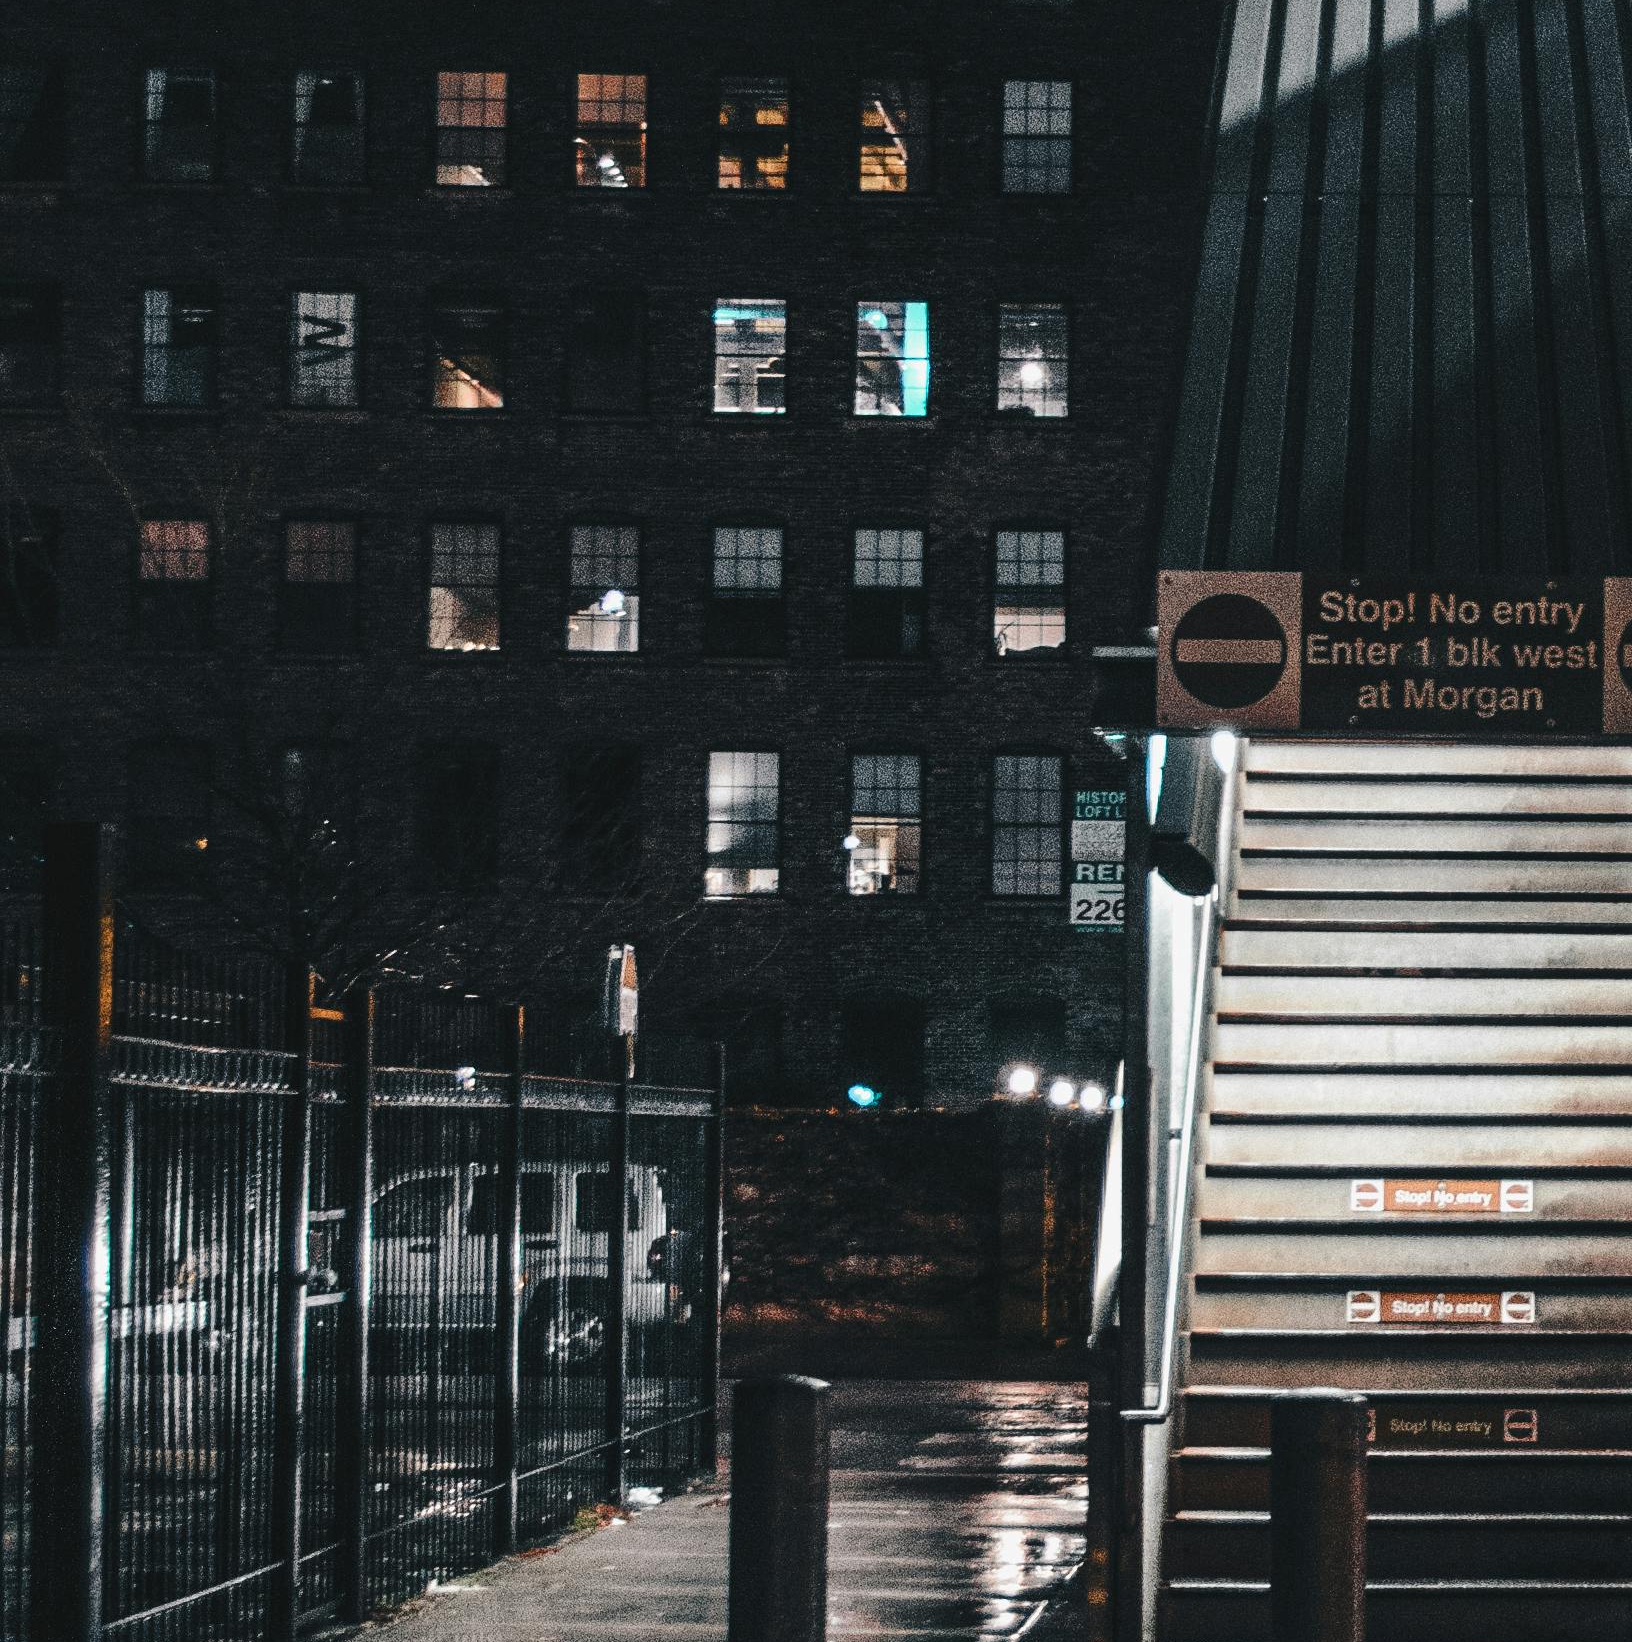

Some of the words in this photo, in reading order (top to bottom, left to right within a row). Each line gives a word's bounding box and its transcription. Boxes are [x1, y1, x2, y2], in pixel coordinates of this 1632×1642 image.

[1319, 590, 1416, 631] Stop!
[1430, 592, 1481, 625] No
[1492, 596, 1585, 633] entry
[1306, 633, 1402, 666] Enter
[1416, 636, 1431, 667] 1
[1448, 636, 1501, 667] blk
[1513, 639, 1598, 668] west
[1358, 679, 1391, 709] at
[1403, 678, 1544, 718] Morgan
[1076, 805, 1111, 818] LOFT
[1395, 1189, 1431, 1205] Stop!
[1433, 1190, 1454, 1203] No
[1456, 1191, 1492, 1206] entry
[1392, 1300, 1430, 1316] Stop!
[1433, 1300, 1454, 1314] No
[1455, 1302, 1491, 1317] entry
[1391, 1418, 1427, 1435] Stop!
[1431, 1419, 1452, 1432] No
[1455, 1420, 1492, 1437] entry
